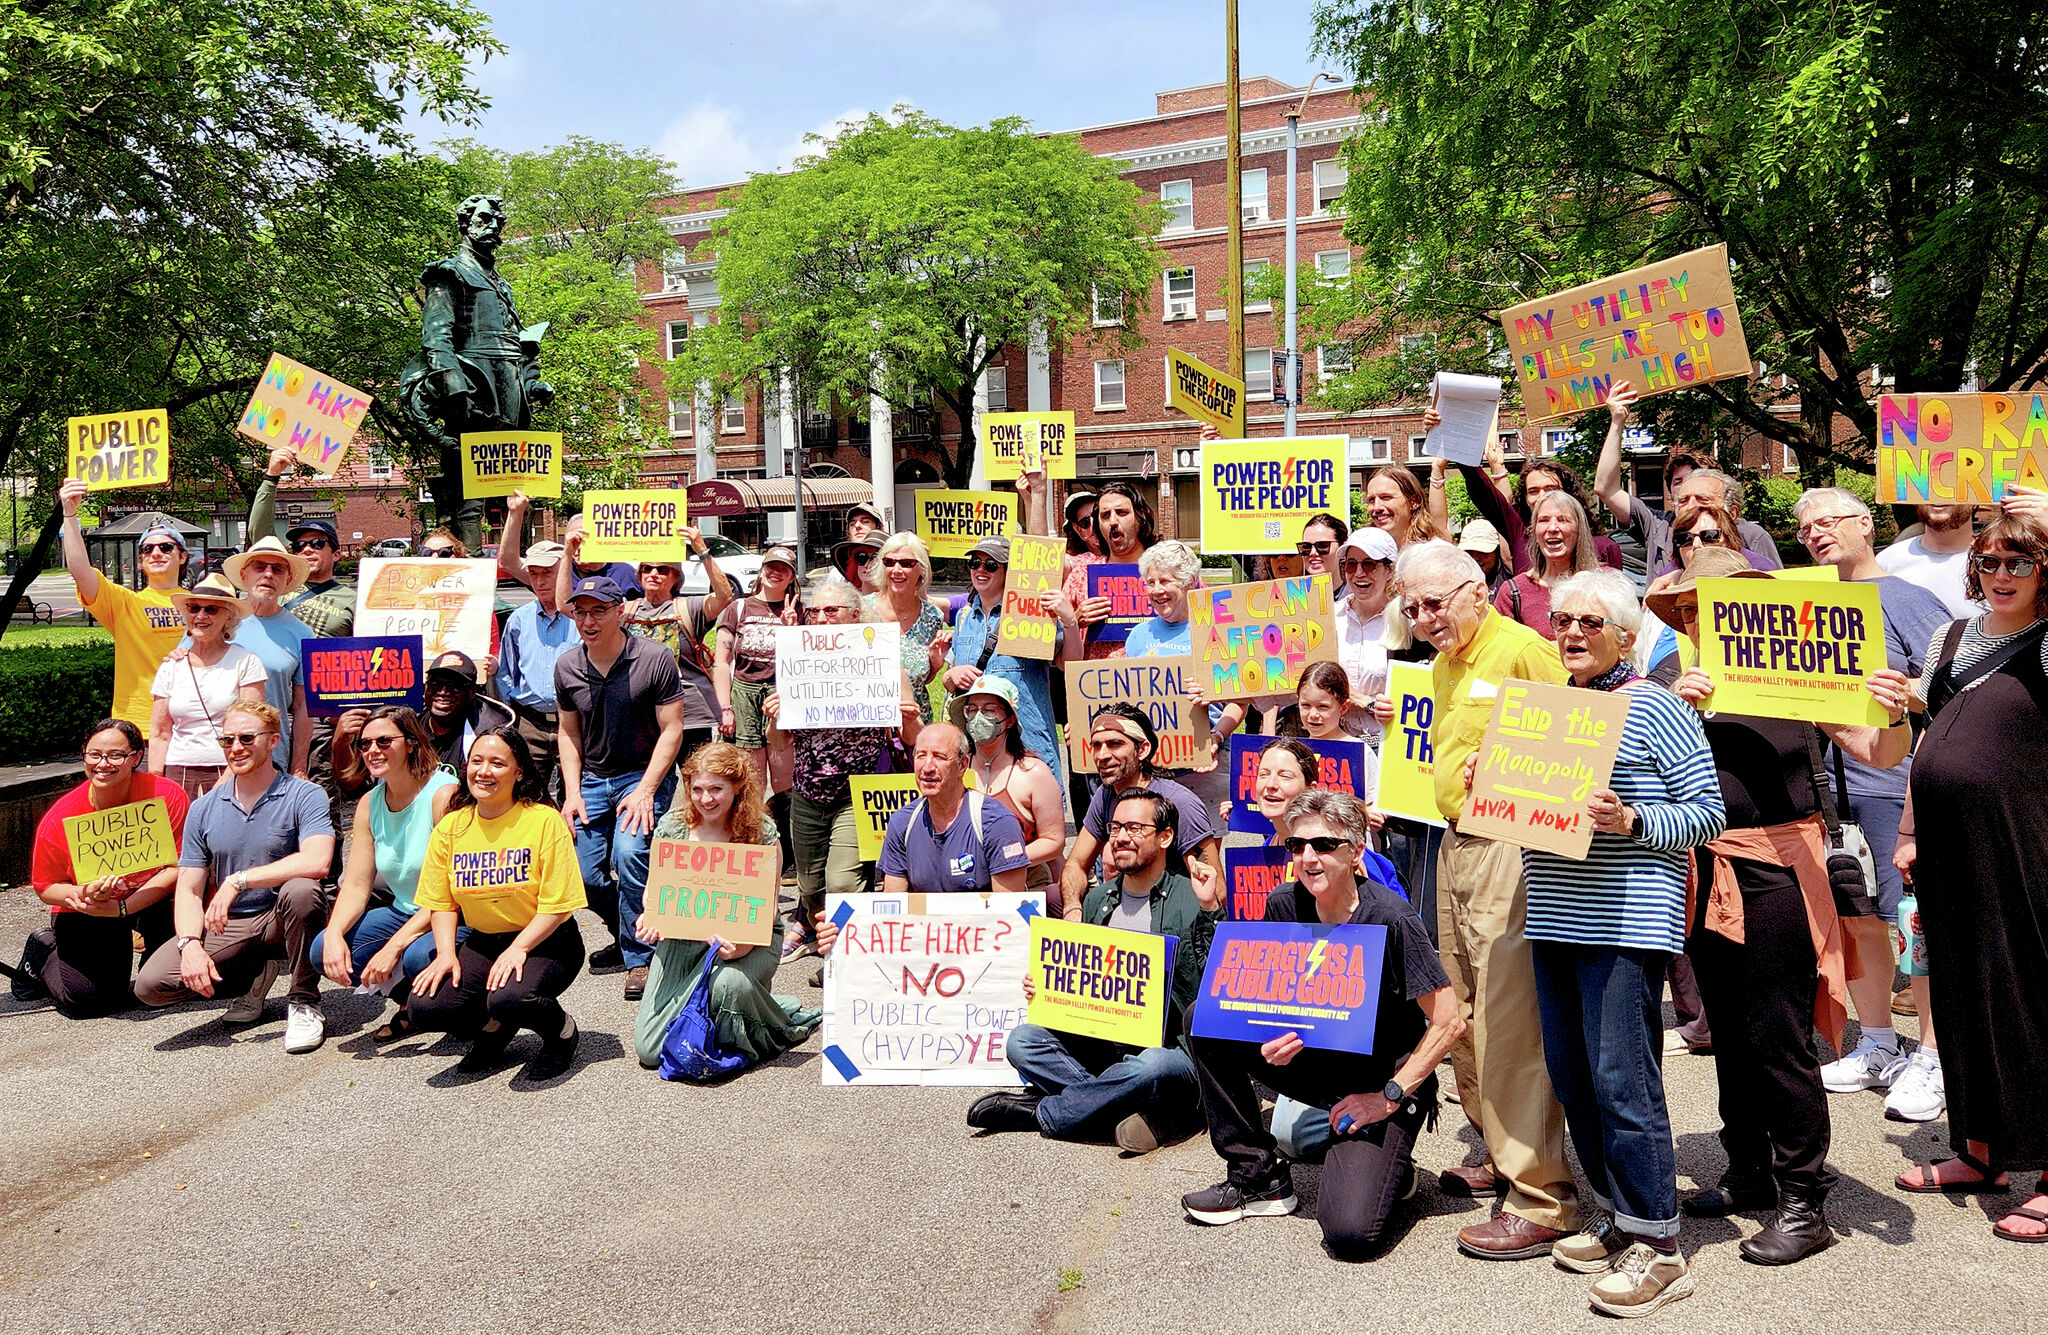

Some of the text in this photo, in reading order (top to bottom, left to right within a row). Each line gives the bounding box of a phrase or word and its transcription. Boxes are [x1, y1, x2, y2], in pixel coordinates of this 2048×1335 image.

[1515, 269, 1689, 345] MY UTILITY
[1522, 308, 1725, 383] BILLS ARE TOO
[265, 358, 368, 429] NO HIKE
[1175, 359, 1236, 405] POWER FOR
[1544, 341, 1716, 415] DAMN HIGH
[1178, 375, 1197, 399] THE
[1197, 386, 1234, 419] PEOPLE
[77, 416, 160, 451] PUBLIC
[244, 398, 340, 463] NO WAY
[990, 423, 1066, 441] POWE FOR
[1881, 396, 1953, 446] NO
[75, 447, 159, 483] POWER
[471, 443, 552, 460] POWER FOR
[993, 440, 1063, 457] THE PPLE
[473, 458, 549, 476] THE PEOPLE
[1213, 459, 1334, 486] POWER FOR
[702, 487, 717, 498] The
[1217, 485, 1330, 511] THE PEOPLE
[592, 502, 676, 520] POWER FOR
[925, 501, 1008, 521] POWER FOR
[928, 518, 1005, 536] THE PEOPLE
[595, 520, 674, 538] THE PEOPLE
[1009, 537, 1066, 572] ENERGY
[387, 569, 466, 592] POWER
[1017, 573, 1049, 593] IS A
[1097, 576, 1147, 596] ENERG
[1005, 590, 1056, 619] PUBL
[1109, 595, 1153, 616] UBLIC
[1188, 574, 1331, 628] WE CAN'T
[149, 616, 173, 628] THE
[384, 616, 461, 636] PEOPLE
[1001, 617, 1057, 644] GOOD
[1713, 601, 1867, 641] POWER FOR
[802, 629, 851, 652] PUBLIC,
[1202, 619, 1325, 662] AFFORD
[1719, 634, 1864, 676] THE PEOPLE
[311, 648, 413, 672] ENERGY IS A
[780, 656, 889, 678] NOT-FOR-PROFIT
[1212, 652, 1306, 695] MORE
[309, 668, 415, 693] PUBLIC GOOD
[867, 680, 900, 699] NOW!
[1078, 666, 1189, 700] CENTRAL
[1723, 673, 1859, 692] THE HUDSON VALLEY POWER AUTHORITY ACT
[805, 702, 898, 724] NO MONOPOLIES!
[1566, 707, 1608, 738] the
[1403, 727, 1433, 764] TH
[1318, 757, 1353, 785] IS A
[1484, 743, 1598, 802] Monopoly
[77, 803, 157, 842] PUBLIC
[1472, 796, 1580, 834] HVPA NOW!
[78, 826, 155, 863] POWER
[96, 841, 160, 875] NOW!
[453, 848, 532, 870] POWER FOR
[658, 841, 764, 878] PEOPLE
[455, 865, 530, 888] THE PEOPLE
[658, 885, 767, 924] PROFIT
[845, 920, 1013, 956] RATE HIKE?
[1040, 936, 1151, 980] POWER FOR
[1221, 938, 1365, 977] ENERGY IS A
[902, 962, 965, 998] NO
[1042, 964, 1147, 1008] THE PEOPLE
[1211, 967, 1366, 1009] PUBLIC GOOD
[853, 999, 1028, 1031] PUBLIC POWER
[1044, 994, 1143, 1020] THE HUDSON VALLEY POWER AUTHORITY ACT
[862, 1030, 1004, 1065] (HVPA) YE
